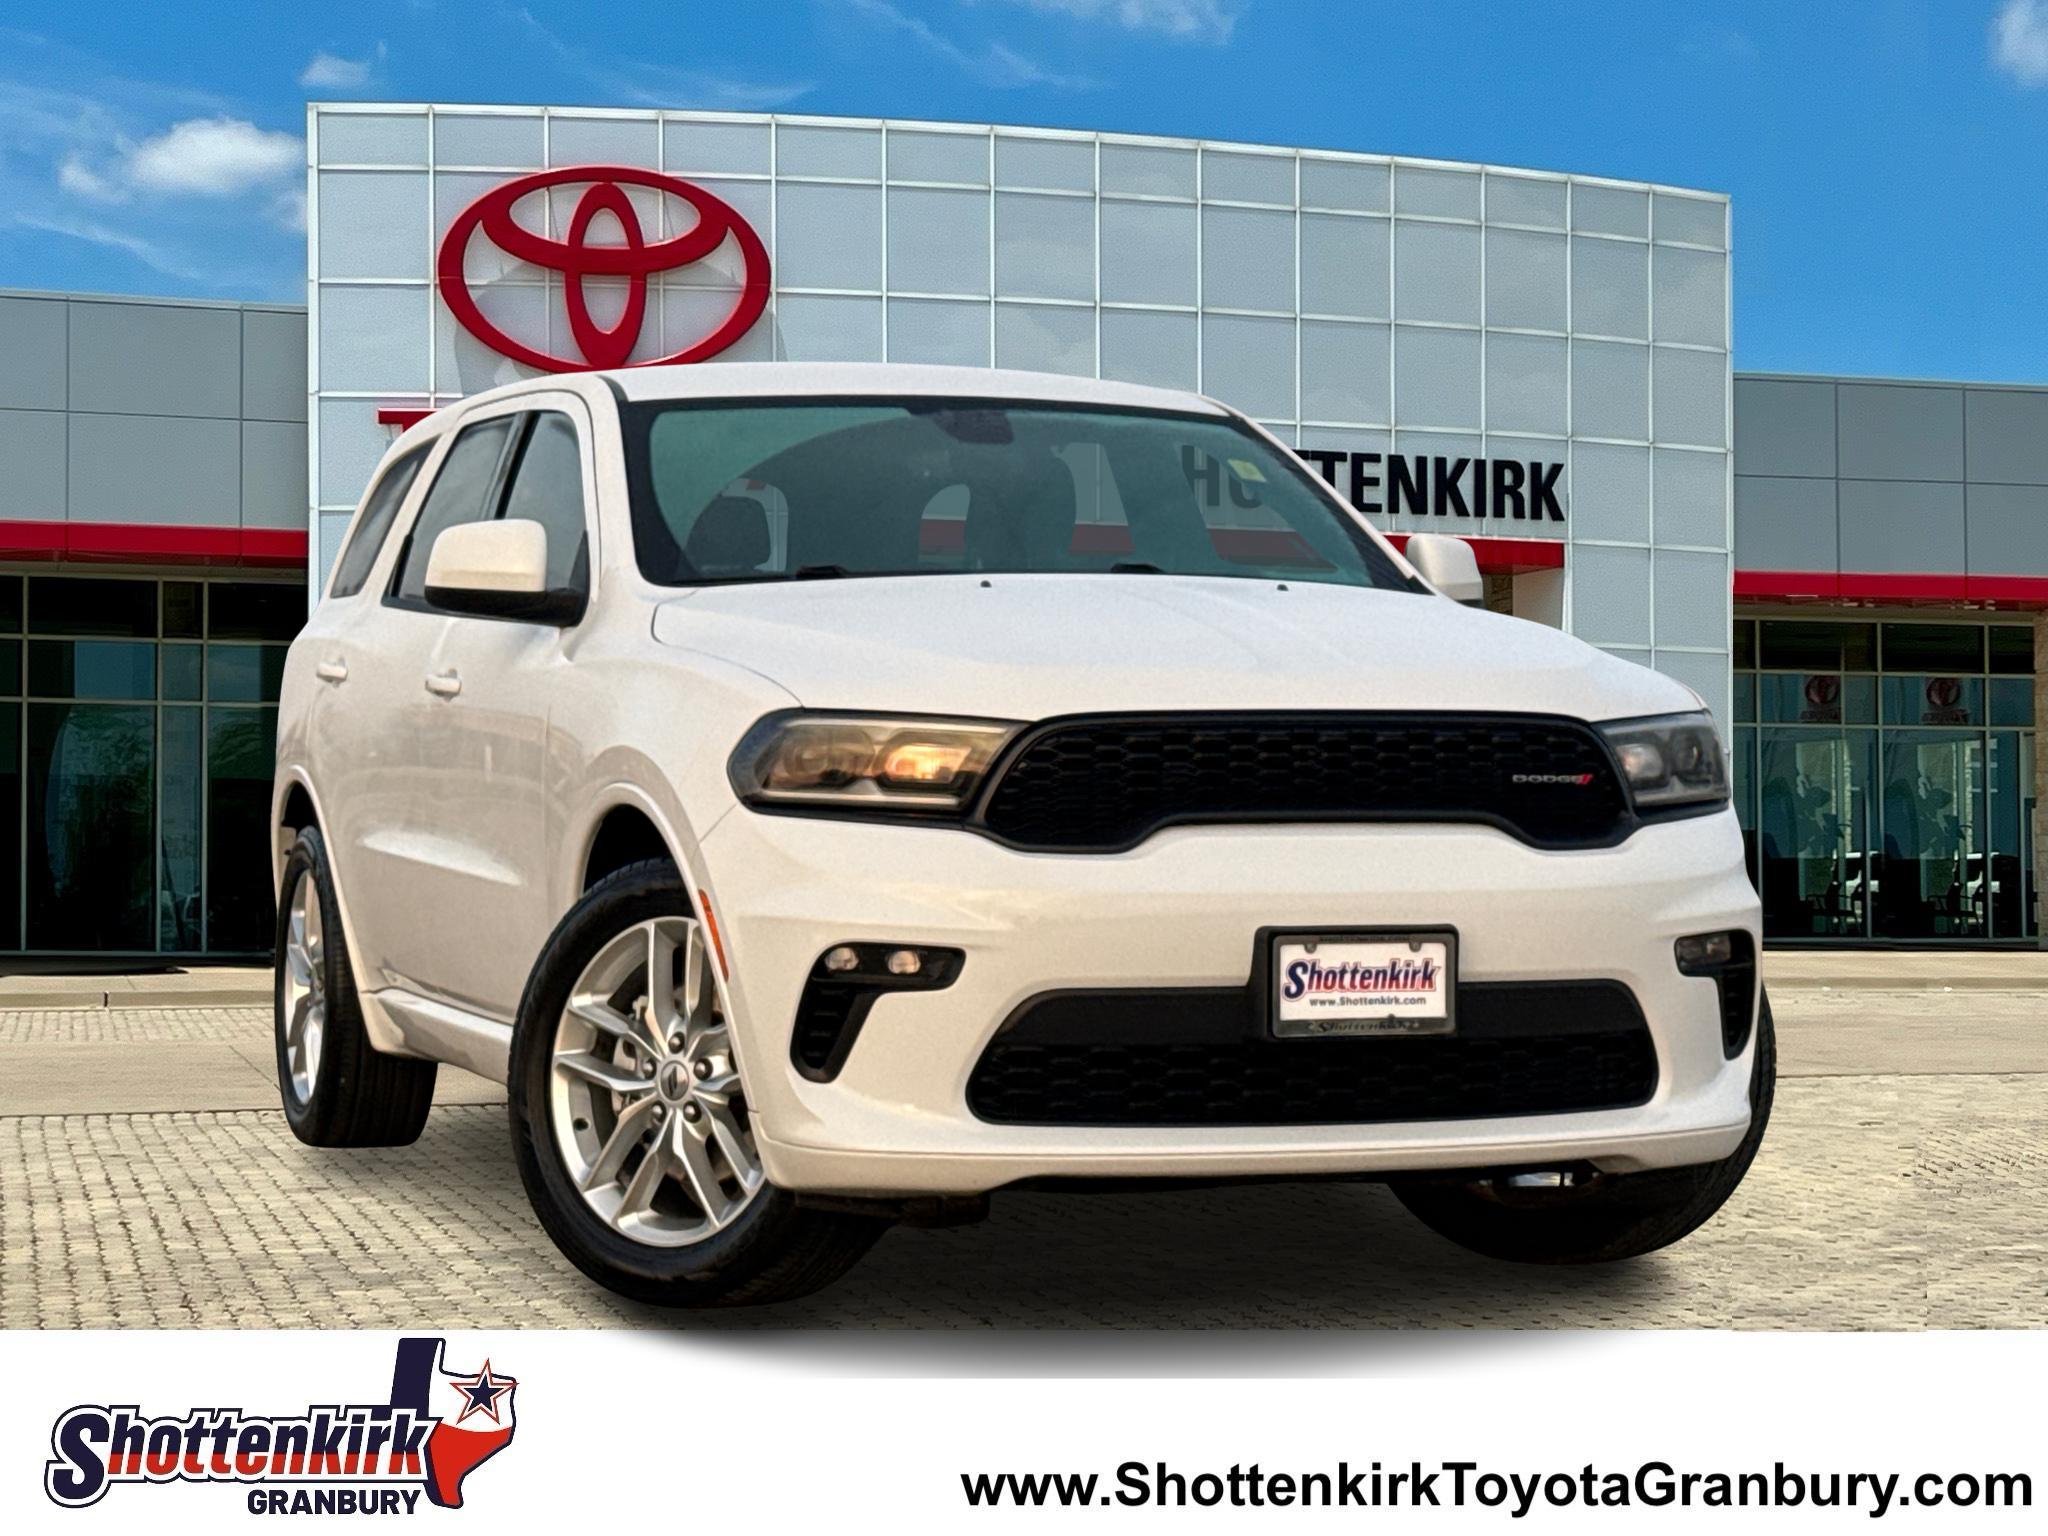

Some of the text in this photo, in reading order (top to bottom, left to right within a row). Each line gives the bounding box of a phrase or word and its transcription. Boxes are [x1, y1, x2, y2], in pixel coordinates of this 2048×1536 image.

[1181, 444, 1565, 522] HTENKIRK
[1512, 774, 1581, 784] DODGE
[1283, 958, 1437, 1000] Shottenkirk
[1309, 996, 1427, 1007] www.Shottenkirk.com
